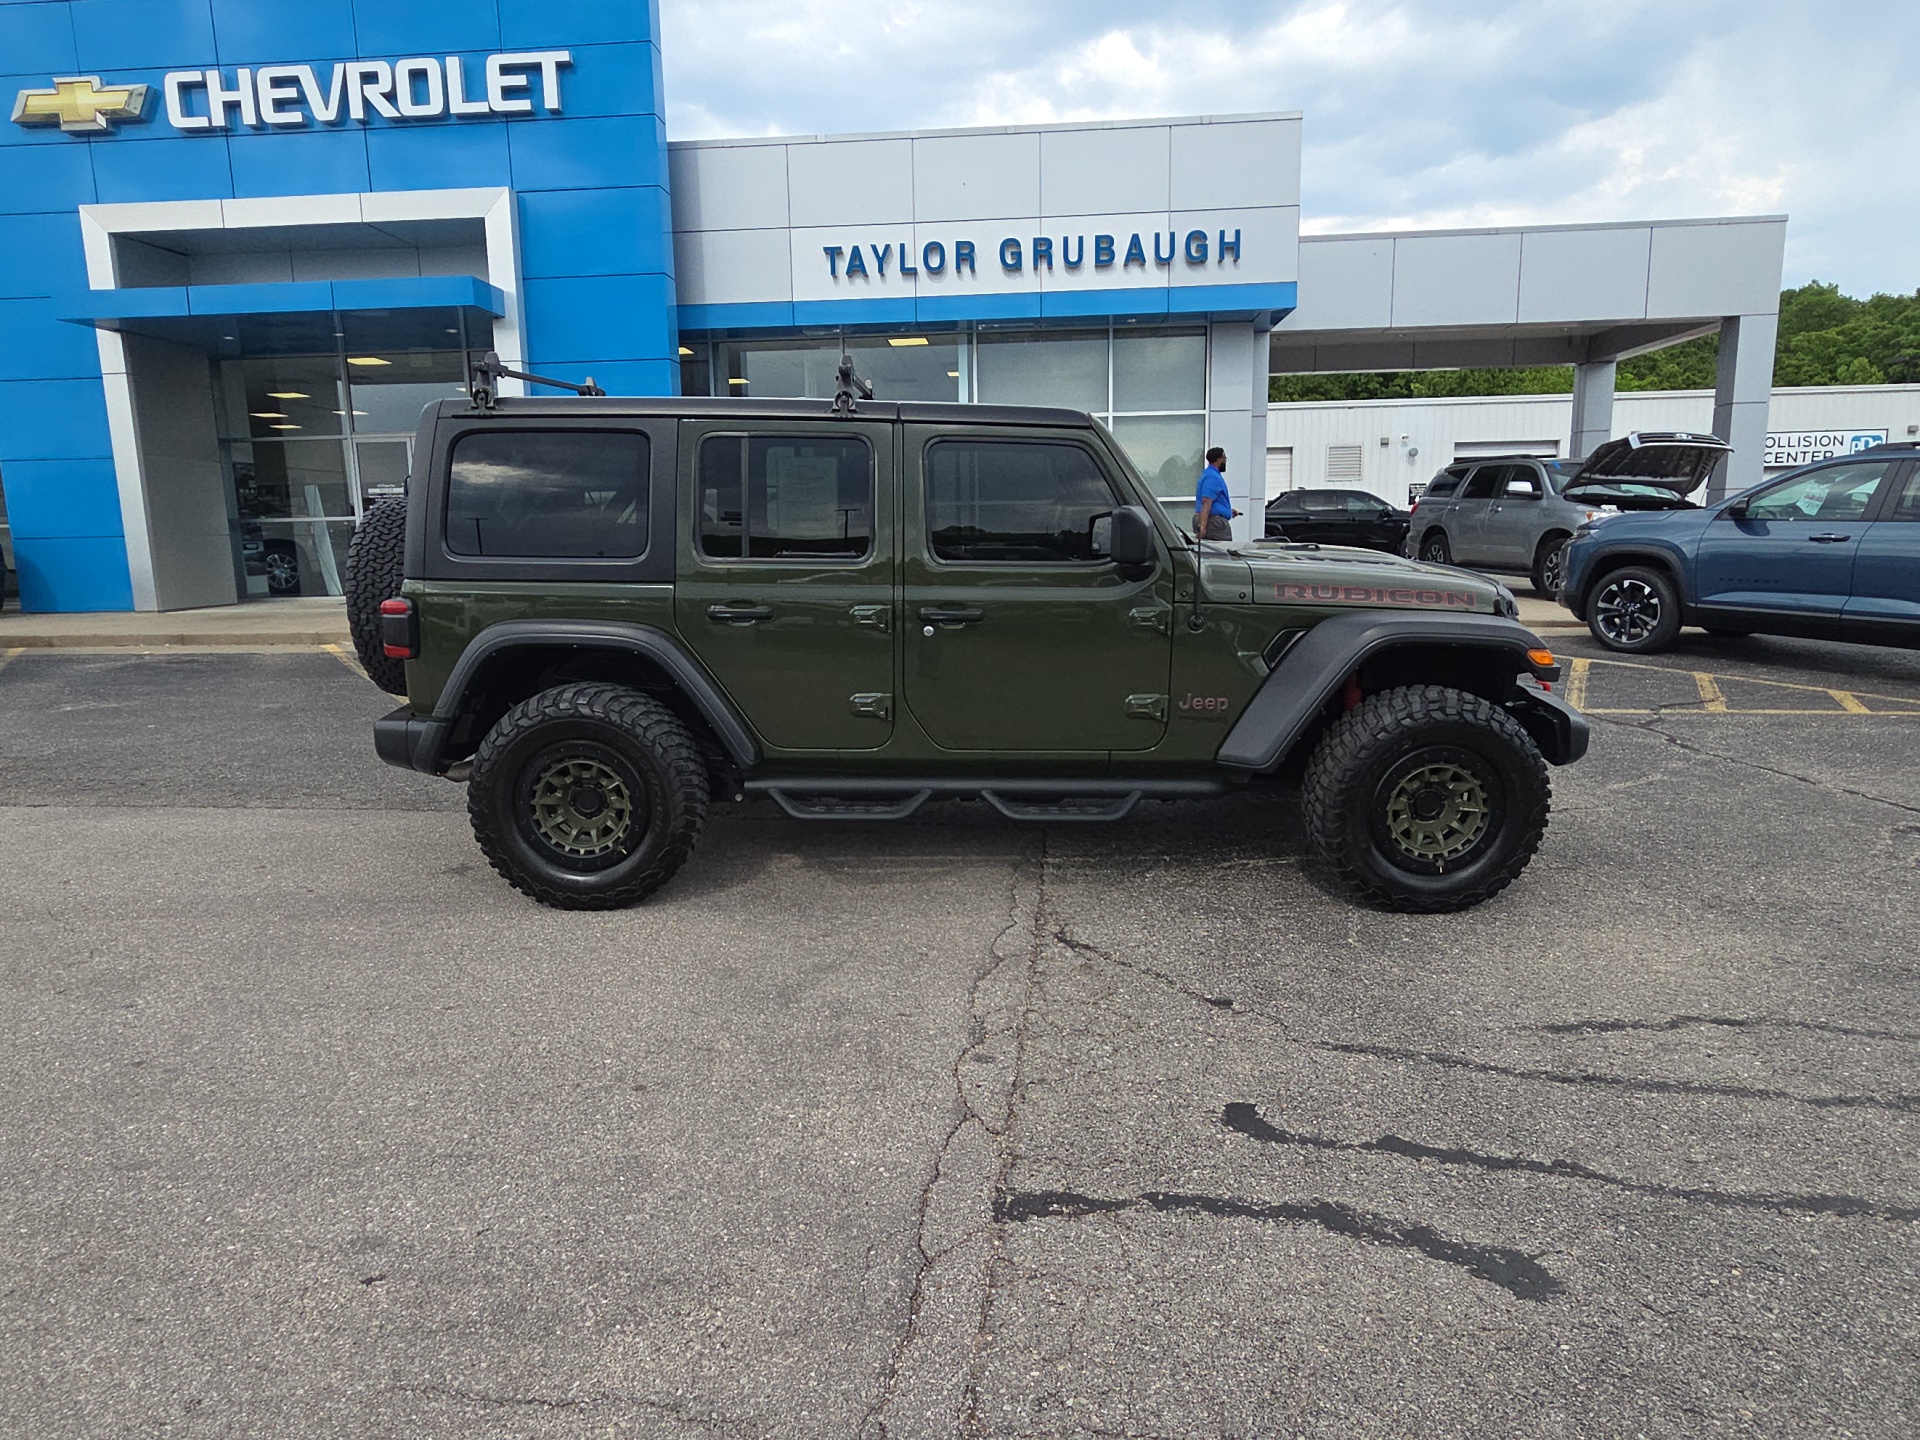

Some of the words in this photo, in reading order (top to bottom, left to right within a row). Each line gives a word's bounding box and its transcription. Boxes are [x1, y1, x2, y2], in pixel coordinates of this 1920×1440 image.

[164, 50, 573, 130] CHEVROLET
[823, 240, 977, 278] TAYLOR
[999, 228, 1242, 272] GRUBAUGH
[1764, 434, 1844, 449] OLLISION
[1274, 582, 1476, 608] RUBICON
[1178, 692, 1229, 714] Jeep
